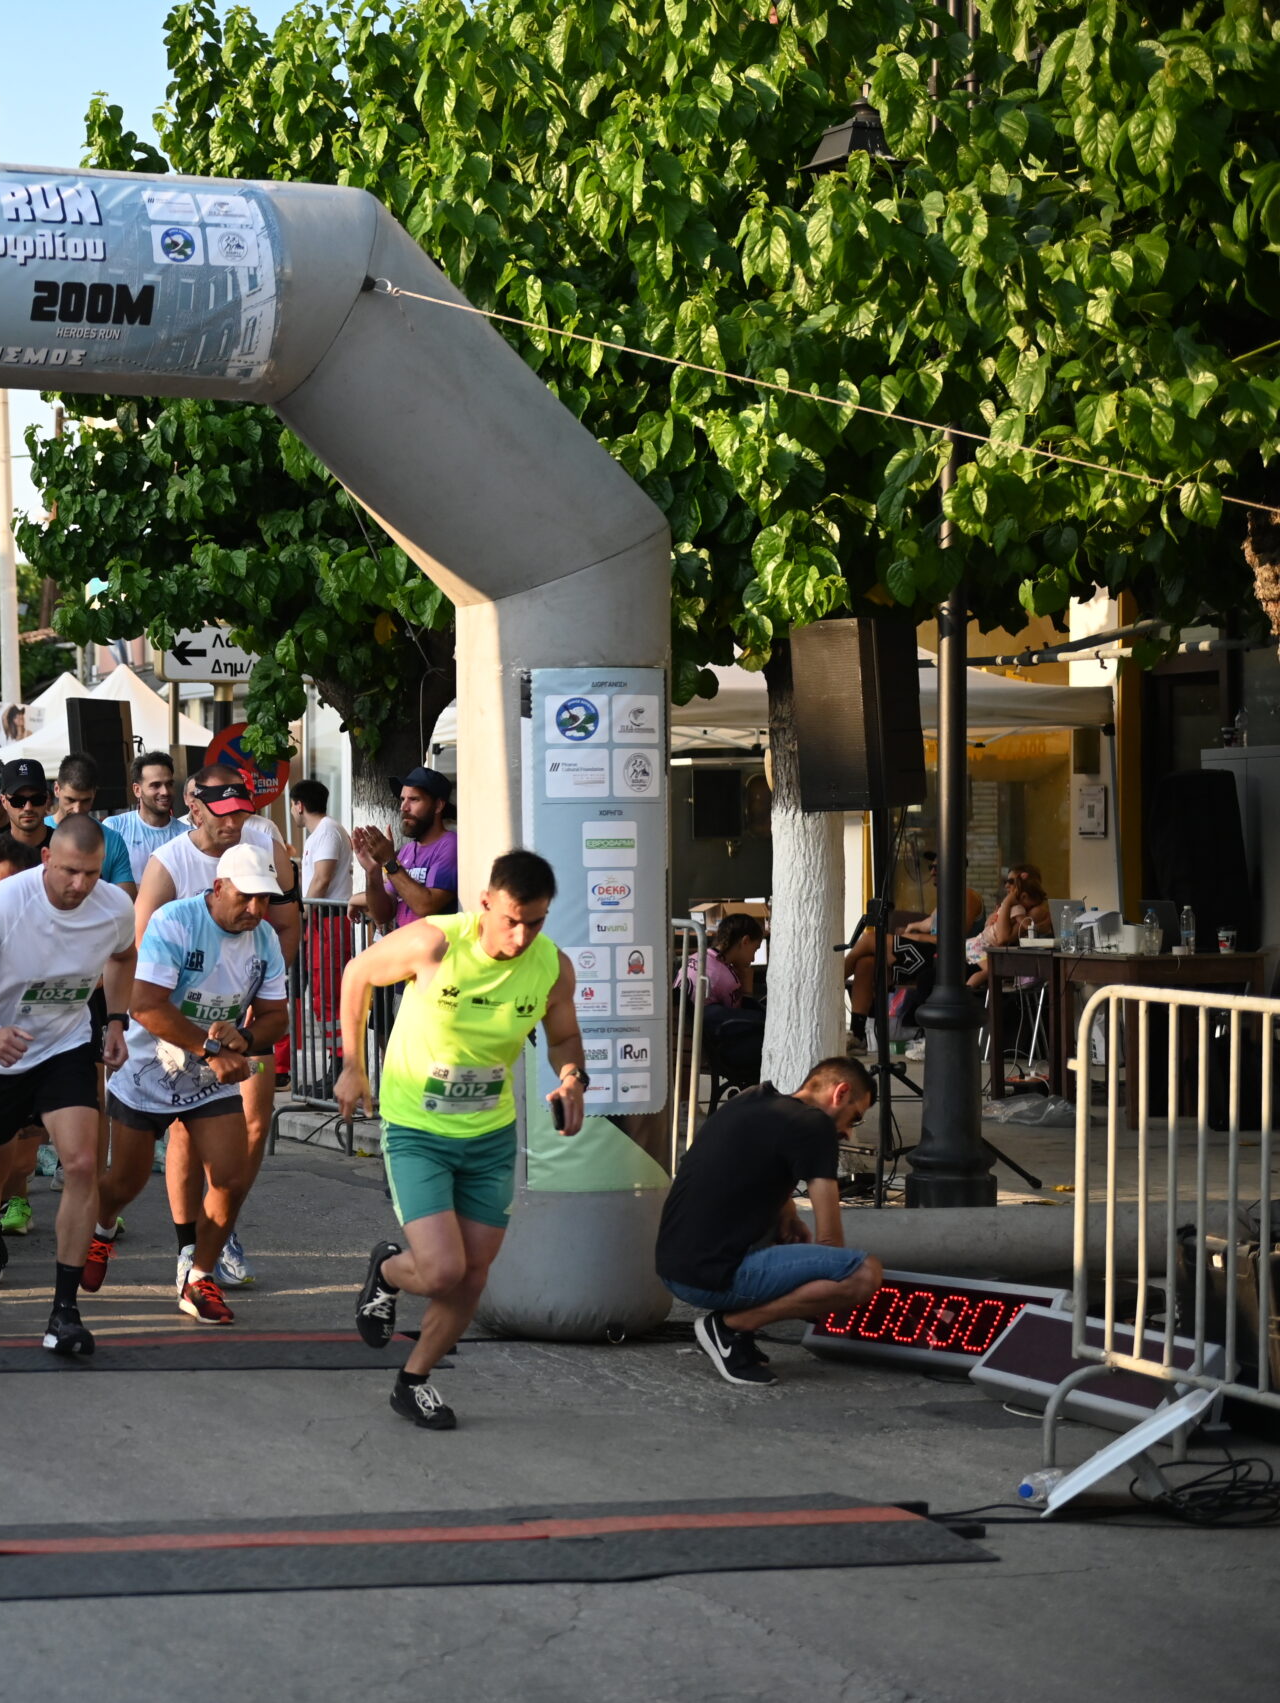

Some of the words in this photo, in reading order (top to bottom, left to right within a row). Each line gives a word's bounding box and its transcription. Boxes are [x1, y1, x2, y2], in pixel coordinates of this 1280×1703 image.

[30, 280, 156, 326] 200M
[56, 326, 97, 339] HEROES
[98, 328, 121, 341] RUN
[211, 659, 256, 677] Δημ/
[598, 886, 626, 895] DEKA
[36, 989, 77, 1000] 1034
[195, 1005, 230, 1020] 1105
[172, 1081, 220, 1105] Runn
[443, 1083, 488, 1097] 1012
